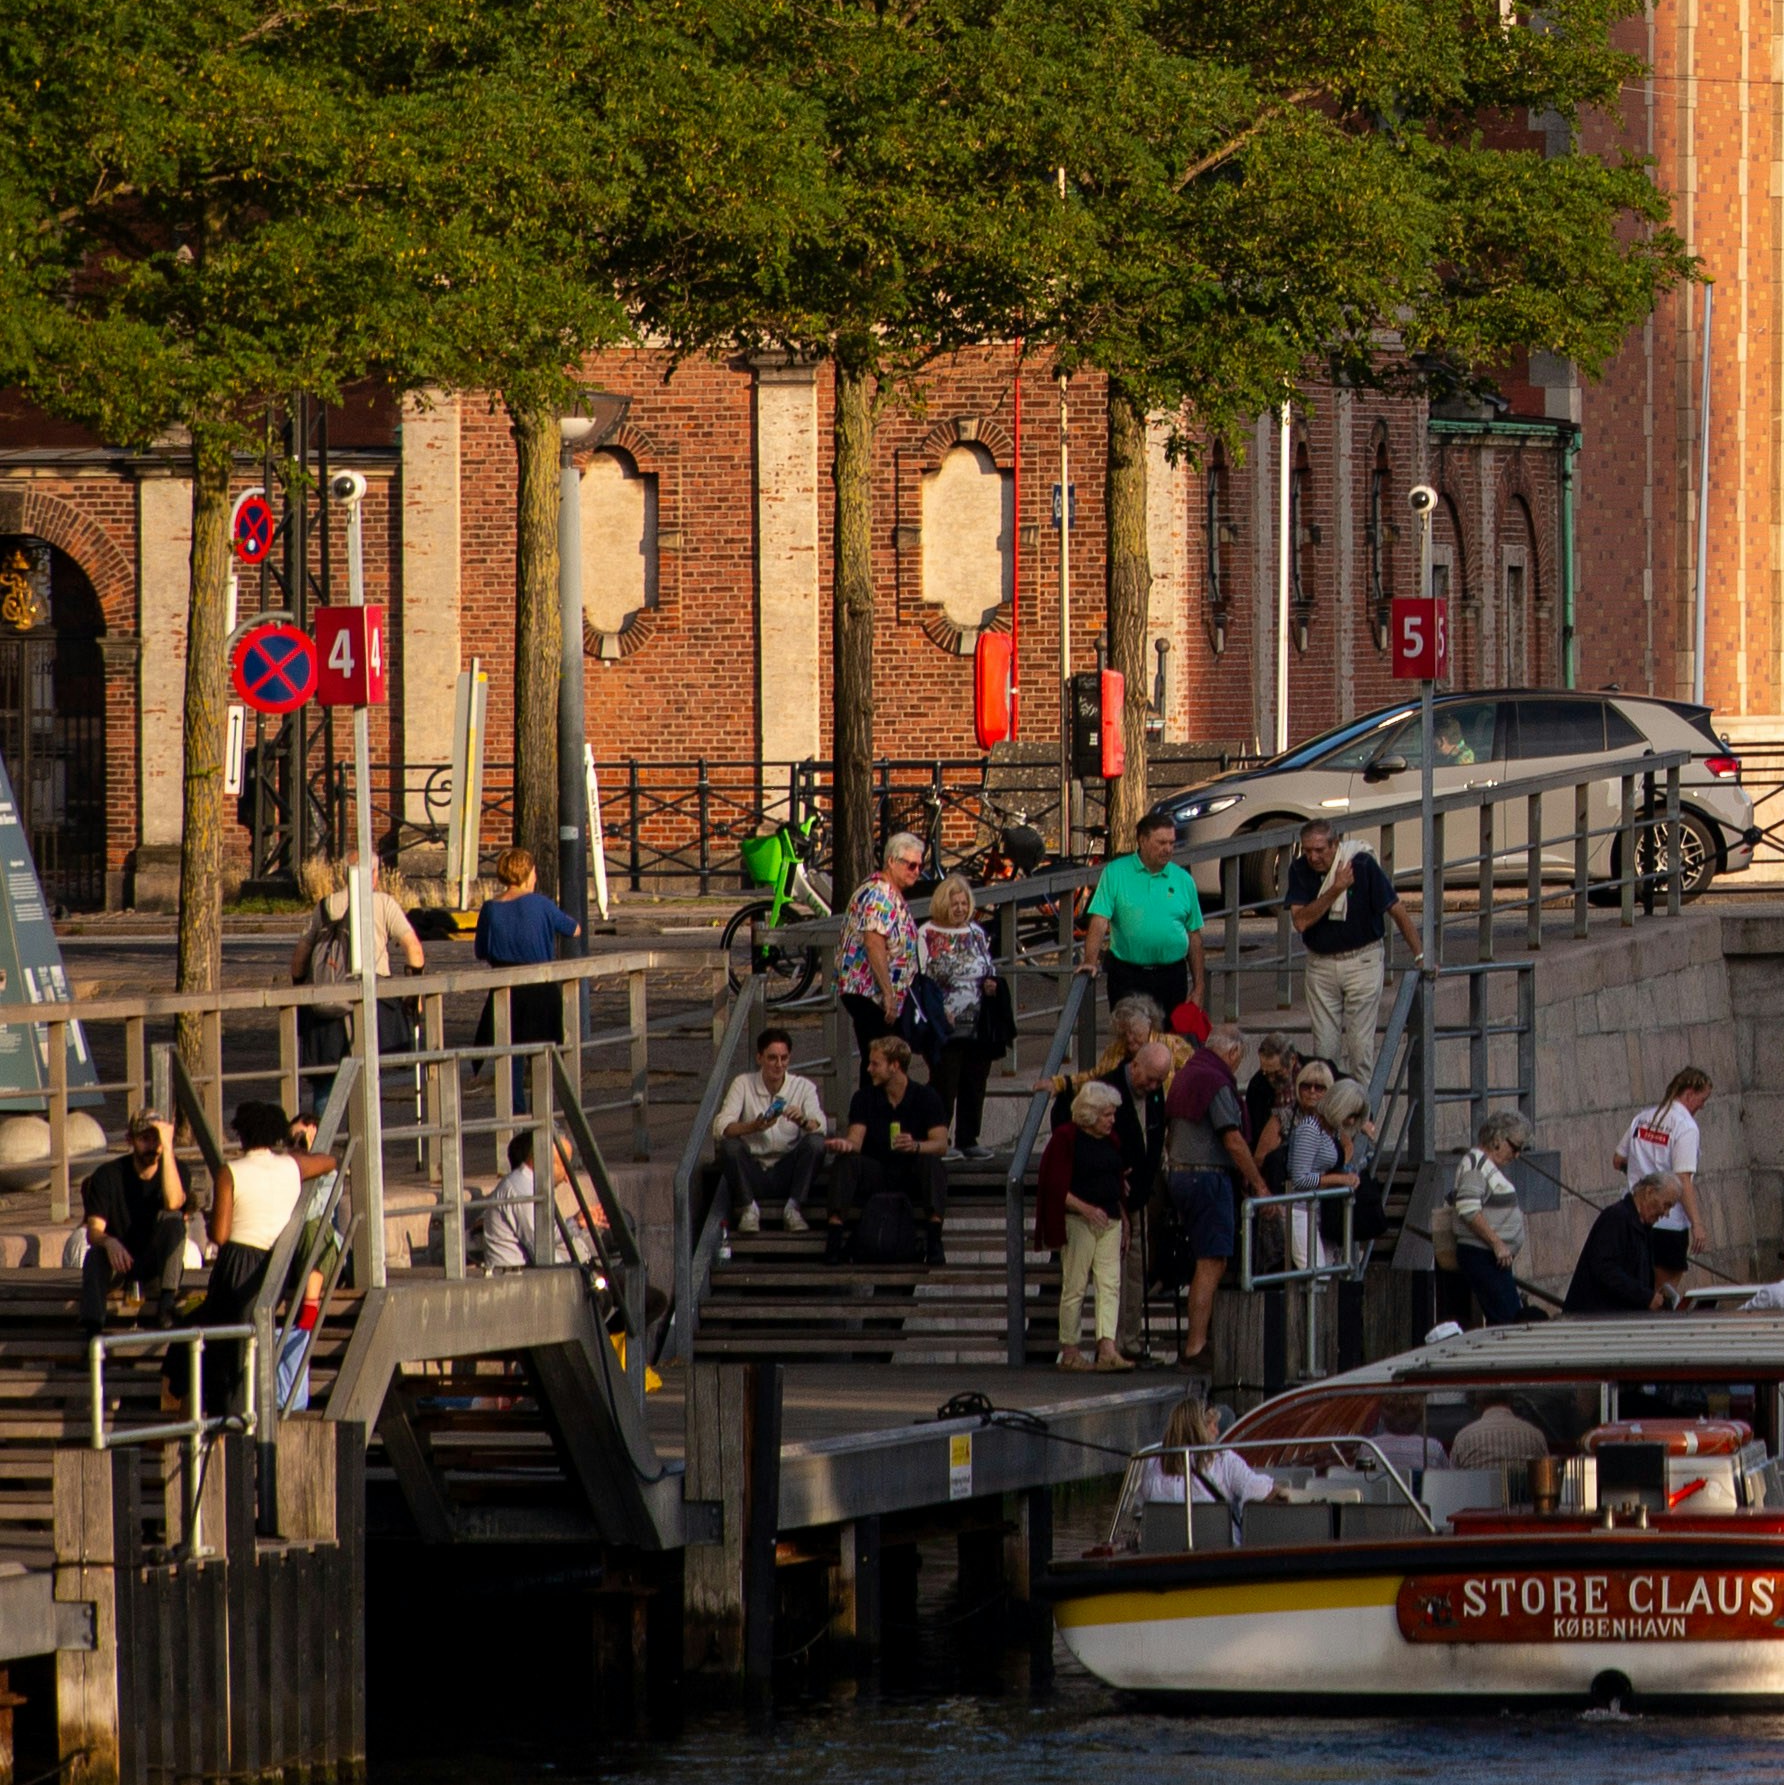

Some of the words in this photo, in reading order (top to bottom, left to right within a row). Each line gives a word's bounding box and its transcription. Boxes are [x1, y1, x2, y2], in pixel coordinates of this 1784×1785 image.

[328, 629, 355, 679] 4
[370, 629, 382, 679] 4
[1402, 616, 1424, 658] 5
[1437, 620, 1447, 658] 5
[1463, 1577, 1609, 1618] STORE
[1628, 1577, 1777, 1617] CLAUS
[1553, 1617, 1687, 1639] KØBENHAVN
